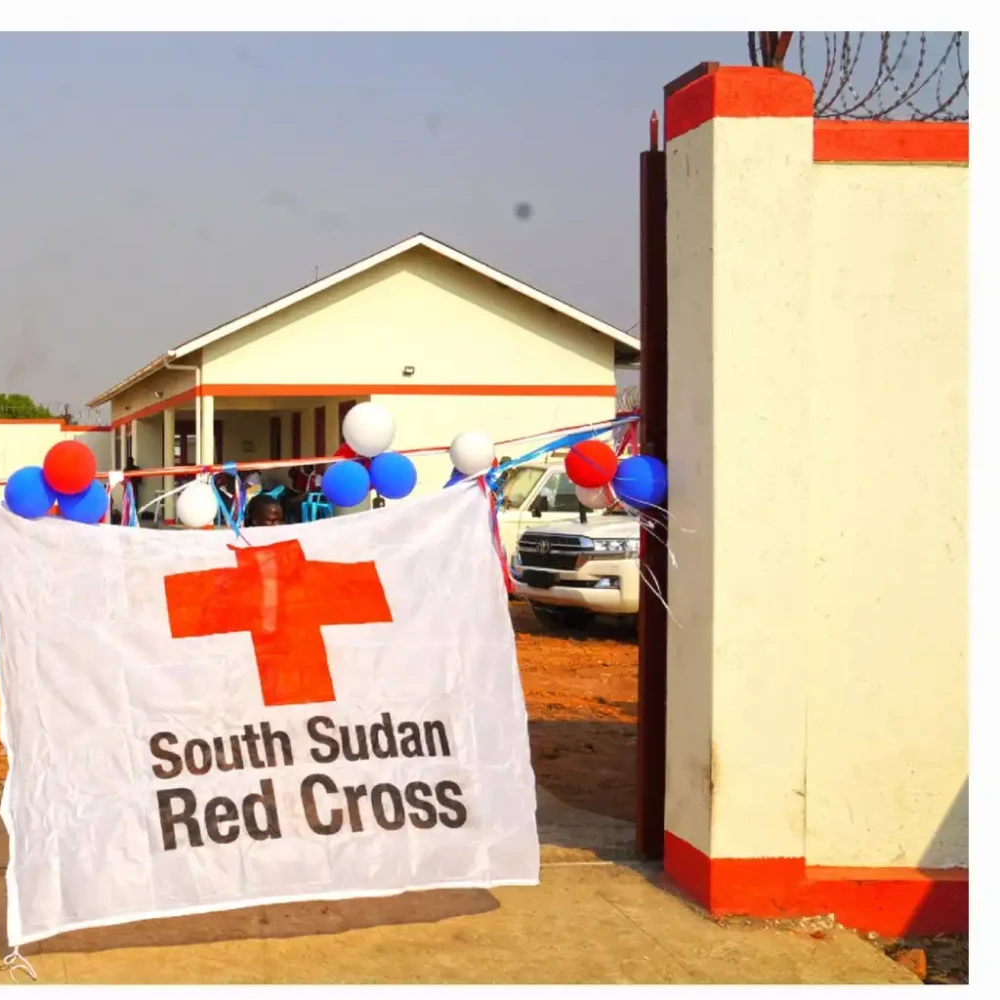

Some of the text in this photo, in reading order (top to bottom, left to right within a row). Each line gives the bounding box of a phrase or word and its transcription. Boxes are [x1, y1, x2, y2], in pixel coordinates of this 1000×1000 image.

[149, 712, 452, 779] South Sudan
[155, 773, 468, 851] Red Cross
